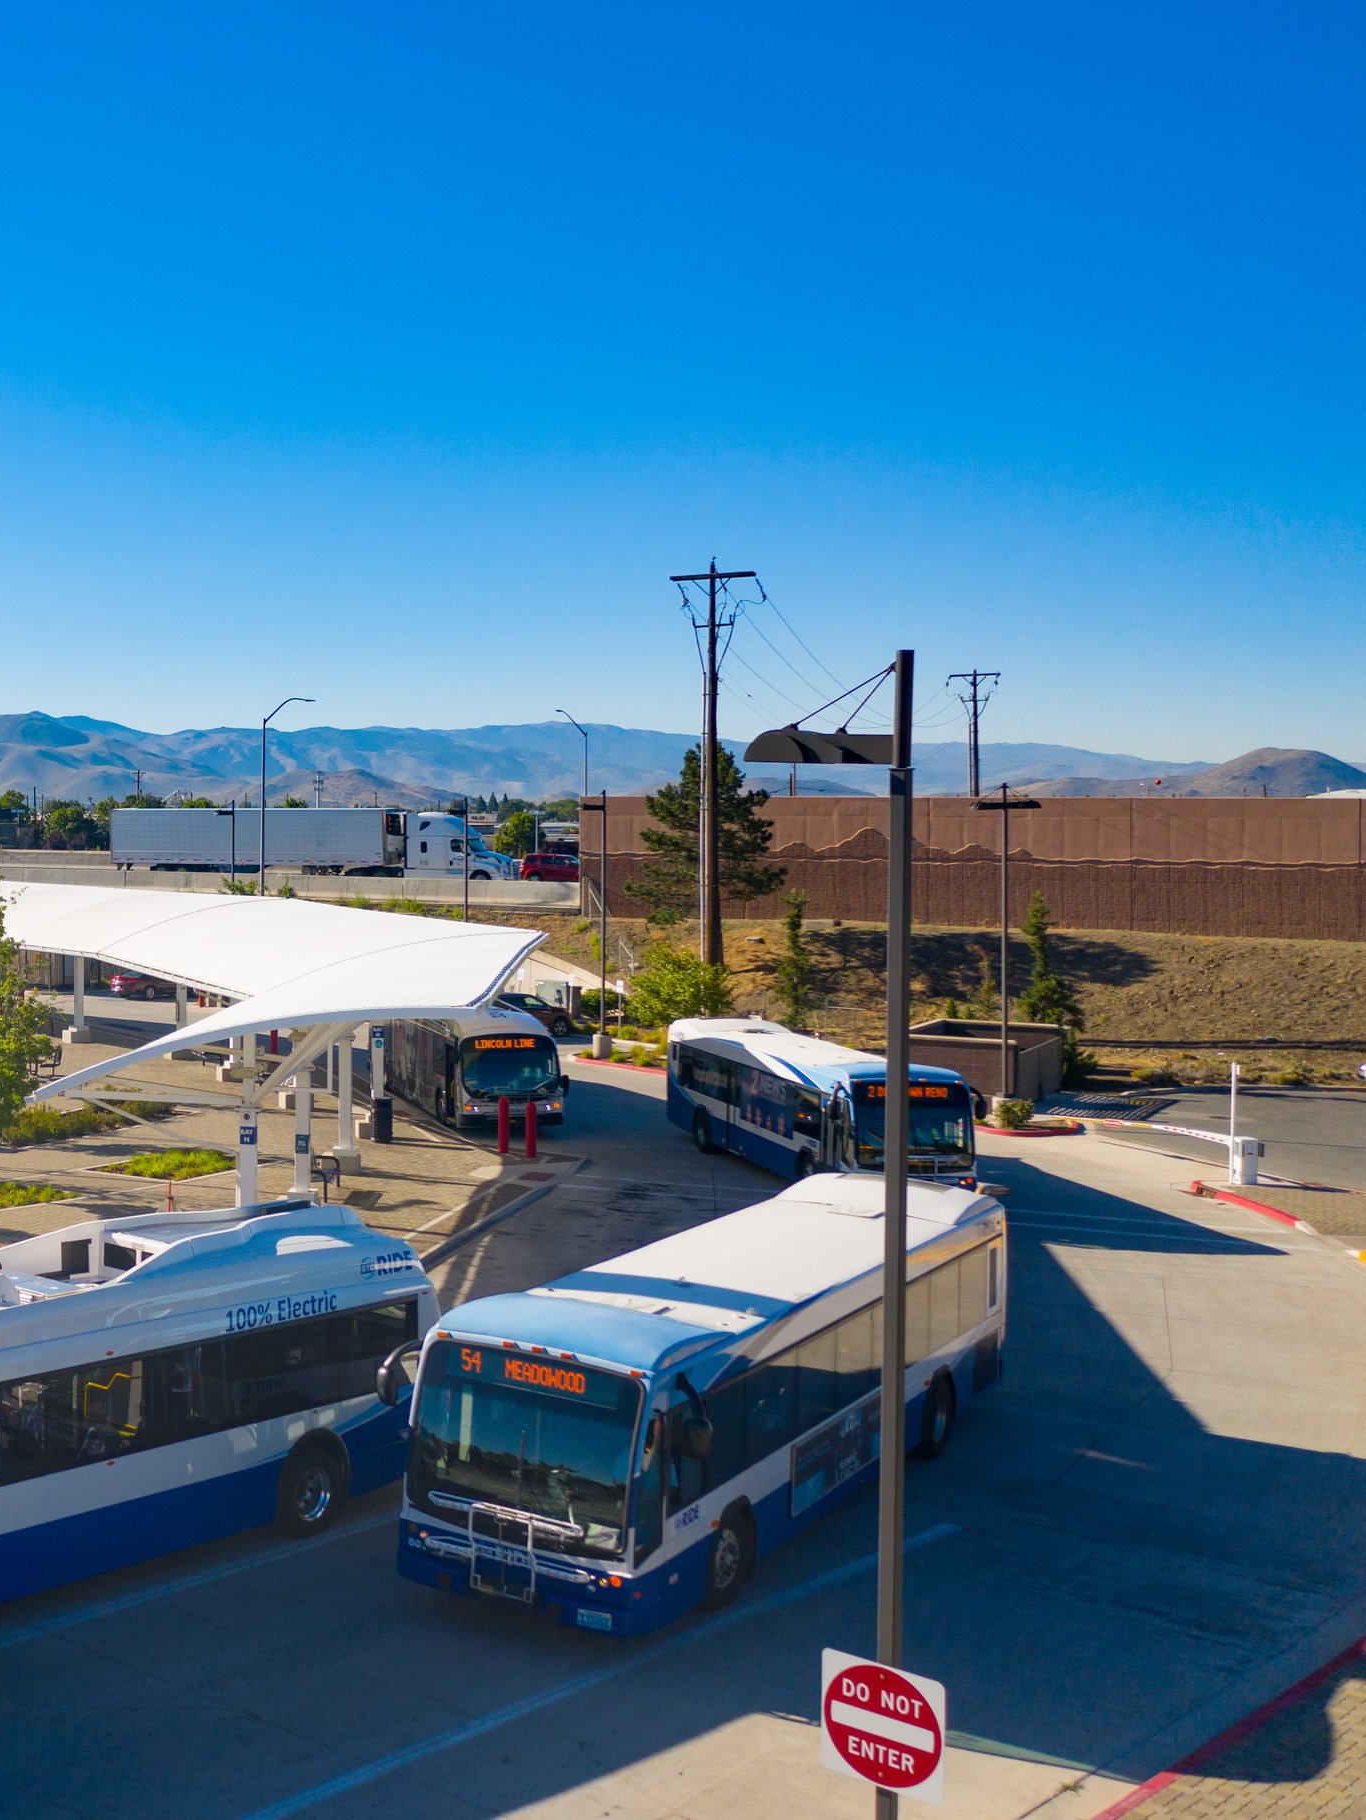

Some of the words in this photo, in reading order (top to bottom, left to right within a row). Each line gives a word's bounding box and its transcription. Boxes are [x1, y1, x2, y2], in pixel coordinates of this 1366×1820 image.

[475, 1039, 512, 1049] LINCOLN
[514, 1038, 535, 1048] LINE
[867, 1085, 875, 1098] 2
[925, 1087, 948, 1098] RENO
[376, 1250, 413, 1276] RIDE
[225, 1302, 272, 1332] 100%
[277, 1289, 338, 1322] Electric
[460, 1347, 482, 1373] 54
[504, 1358, 587, 1395] MEADOWOOD
[841, 1677, 870, 1703] DO
[880, 1688, 924, 1720] NOT
[847, 1734, 915, 1776] ENTER
